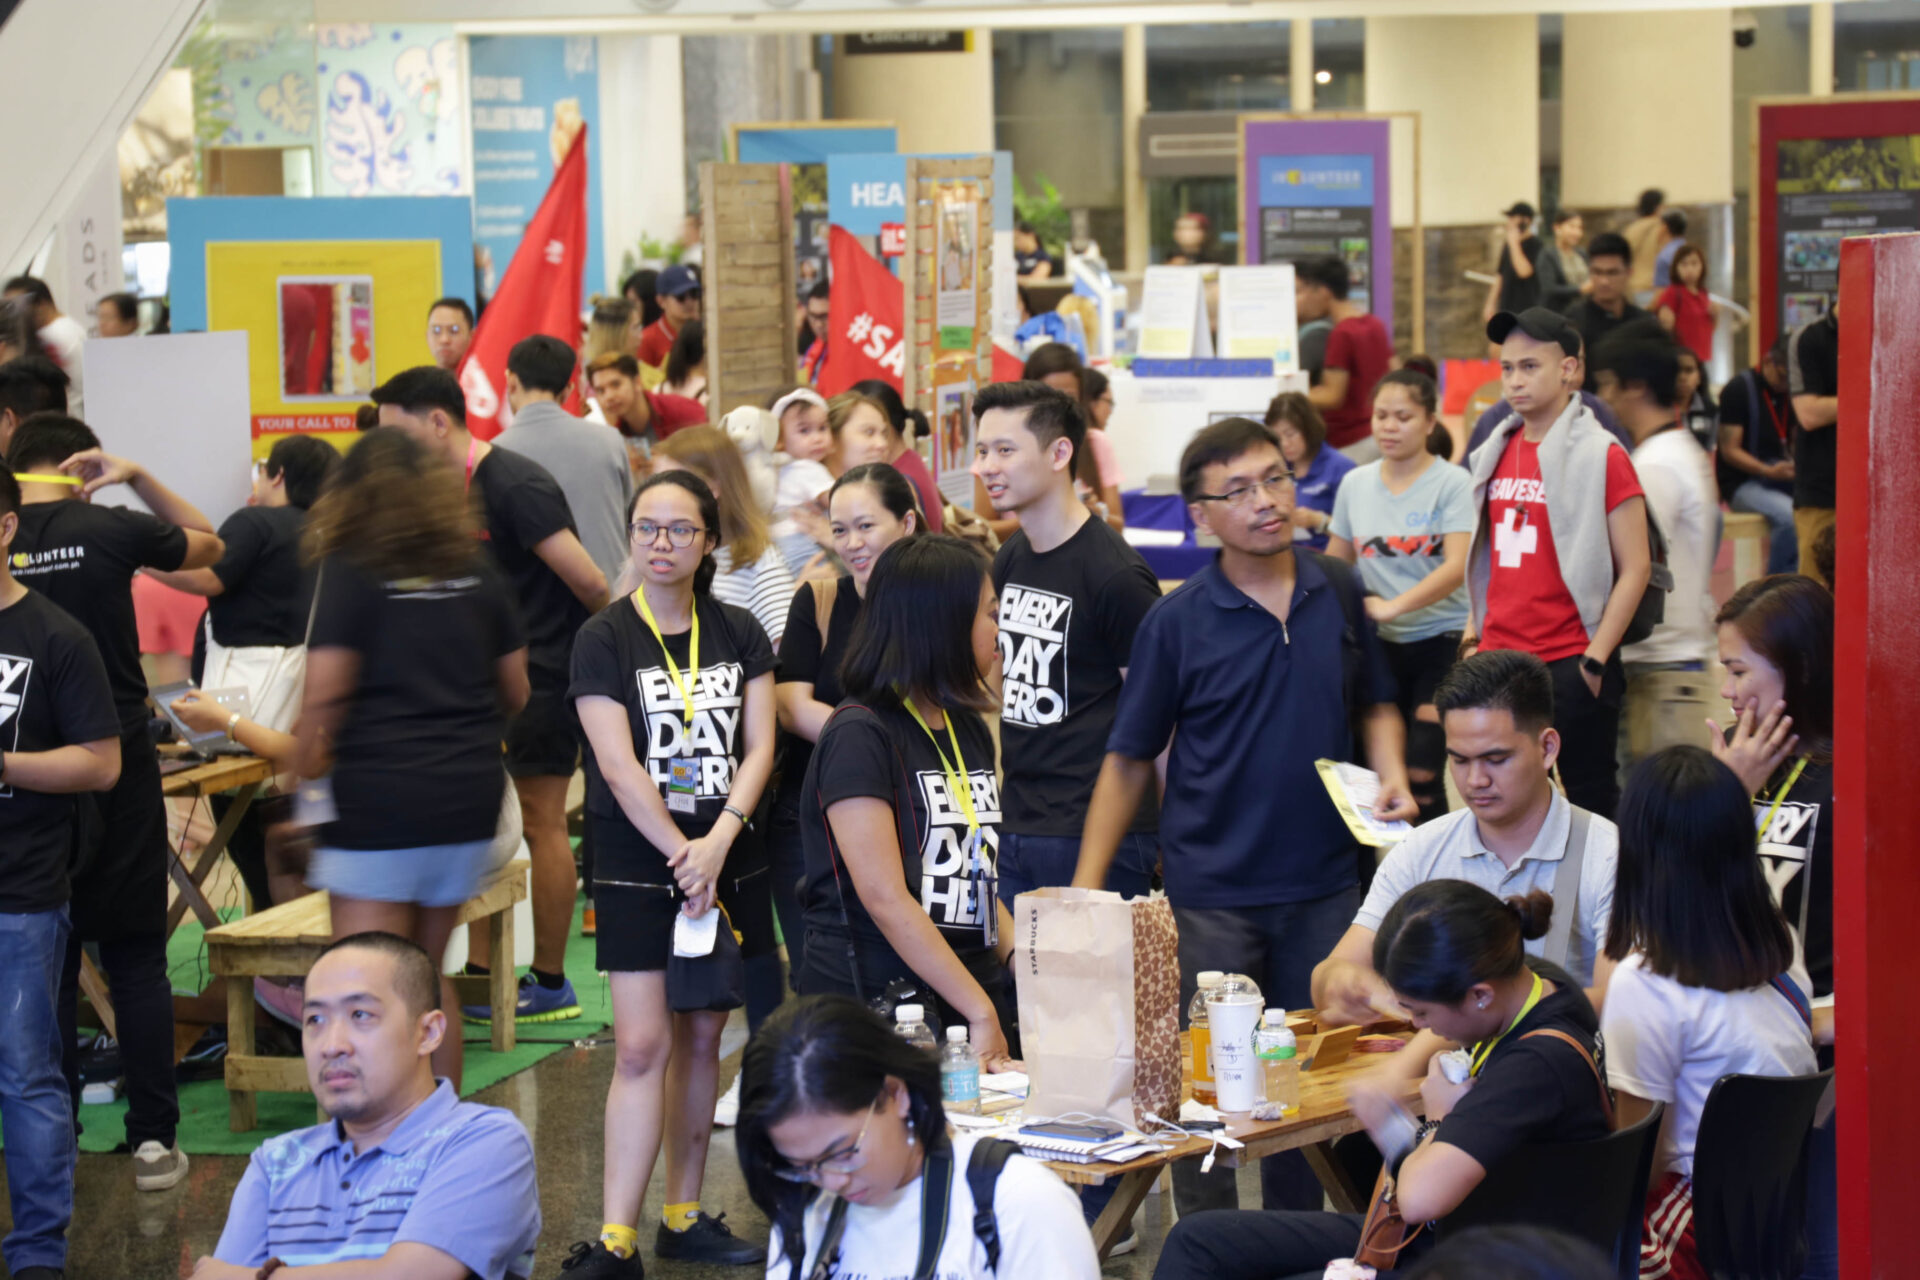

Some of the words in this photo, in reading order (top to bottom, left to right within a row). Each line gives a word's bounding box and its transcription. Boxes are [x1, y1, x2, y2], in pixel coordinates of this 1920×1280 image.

[258, 417, 295, 430] YOUR
[297, 416, 331, 429] CALL
[332, 415, 351, 428] TO
[1000, 586, 1070, 630] EVERY
[1002, 677, 1064, 725] ERO
[649, 707, 739, 759] DAY
[1029, 908, 1039, 977] STARBUCKS
